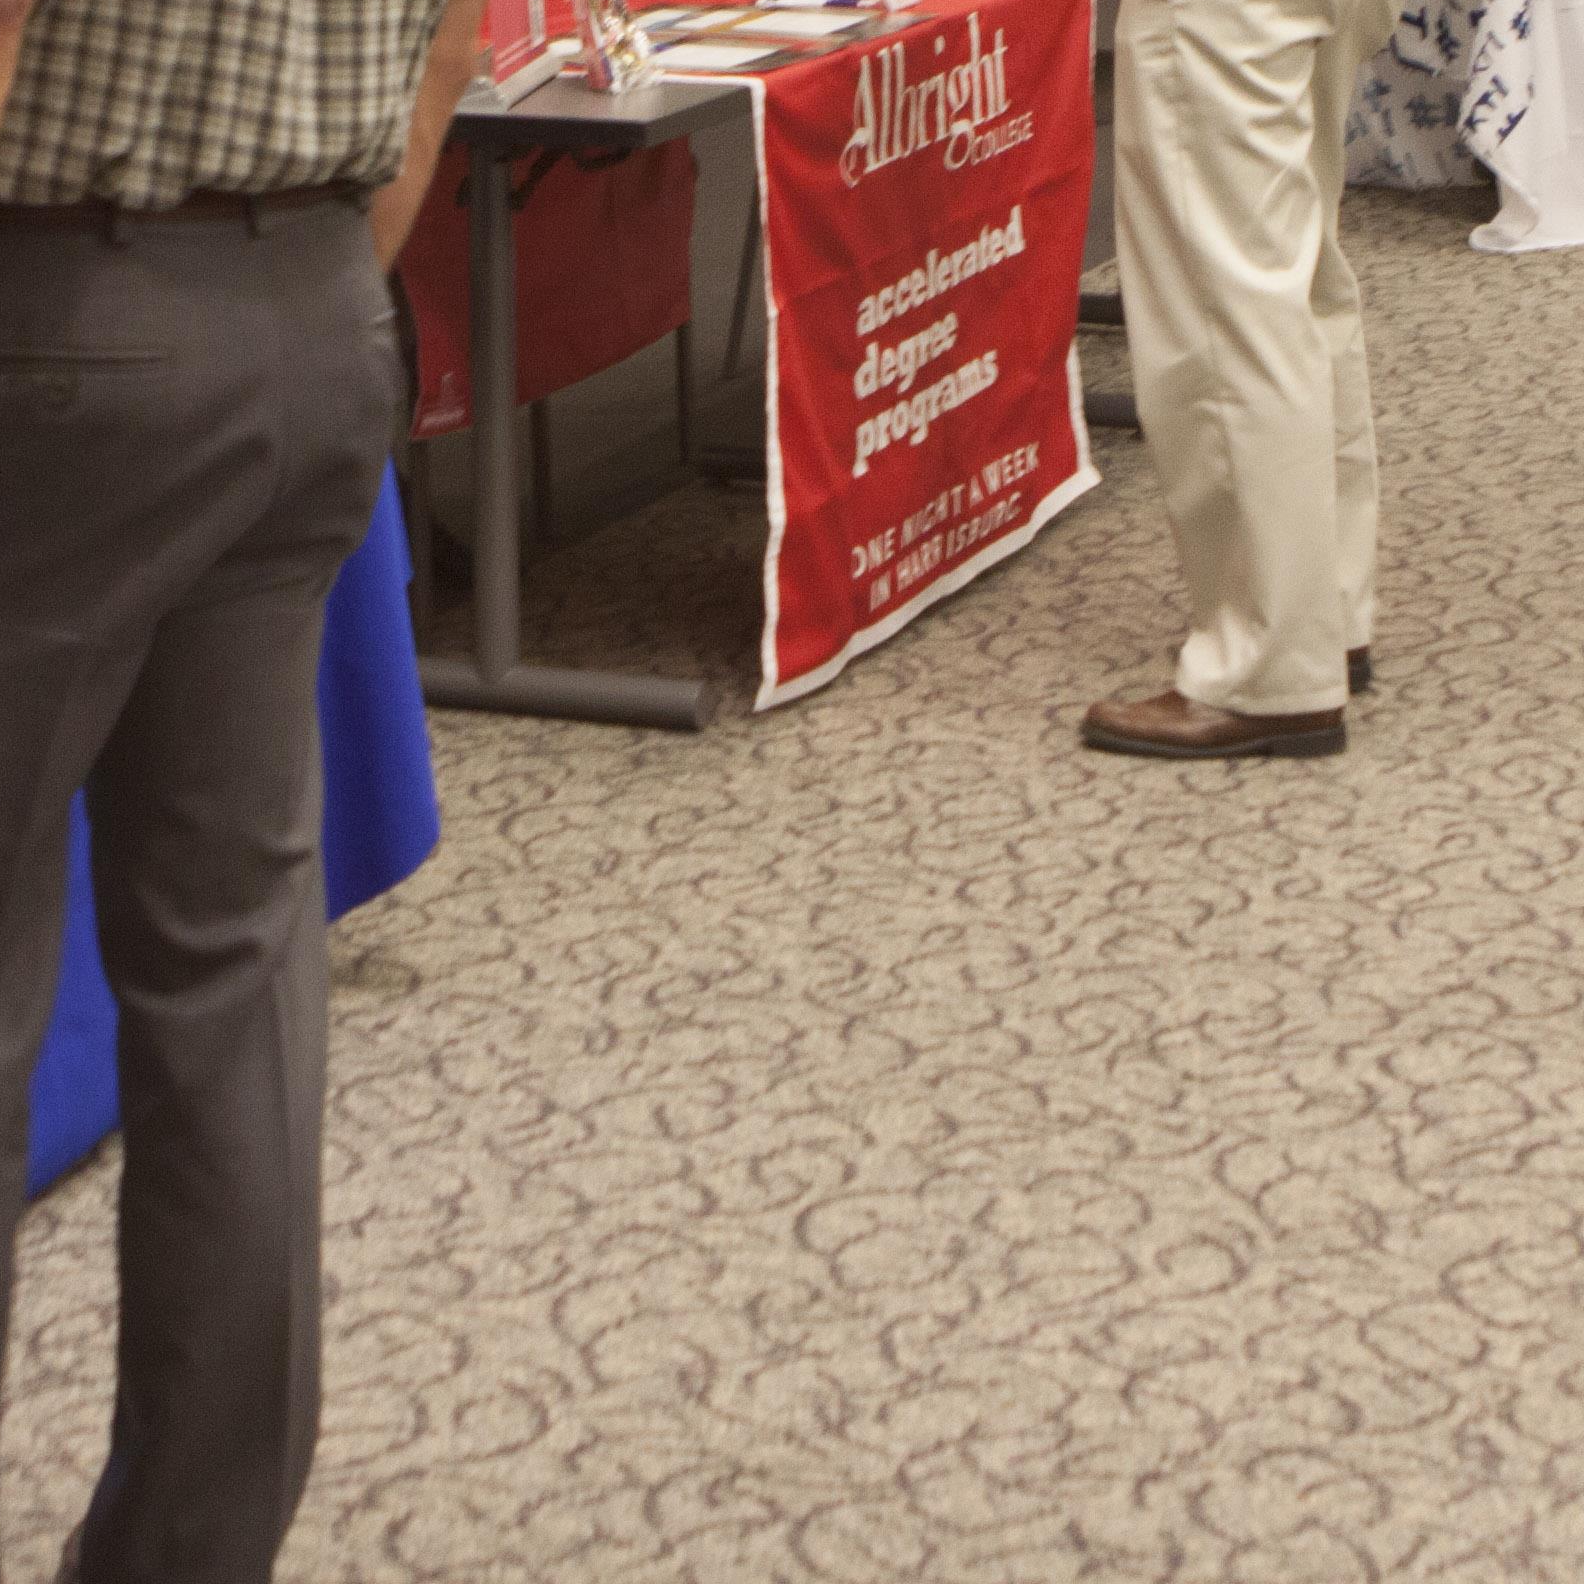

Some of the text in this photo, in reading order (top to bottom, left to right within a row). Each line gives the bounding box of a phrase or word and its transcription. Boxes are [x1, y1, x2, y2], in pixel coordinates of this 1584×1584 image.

[839, 11, 1012, 189] Albright
[971, 110, 1034, 166] COLLEGE
[856, 203, 1026, 338] accelerated
[852, 349, 999, 479] programs
[854, 312, 958, 401] degree
[852, 441, 1040, 579] ONE NIGHT A WEEK
[869, 491, 1023, 612] IN HARRISBURG
